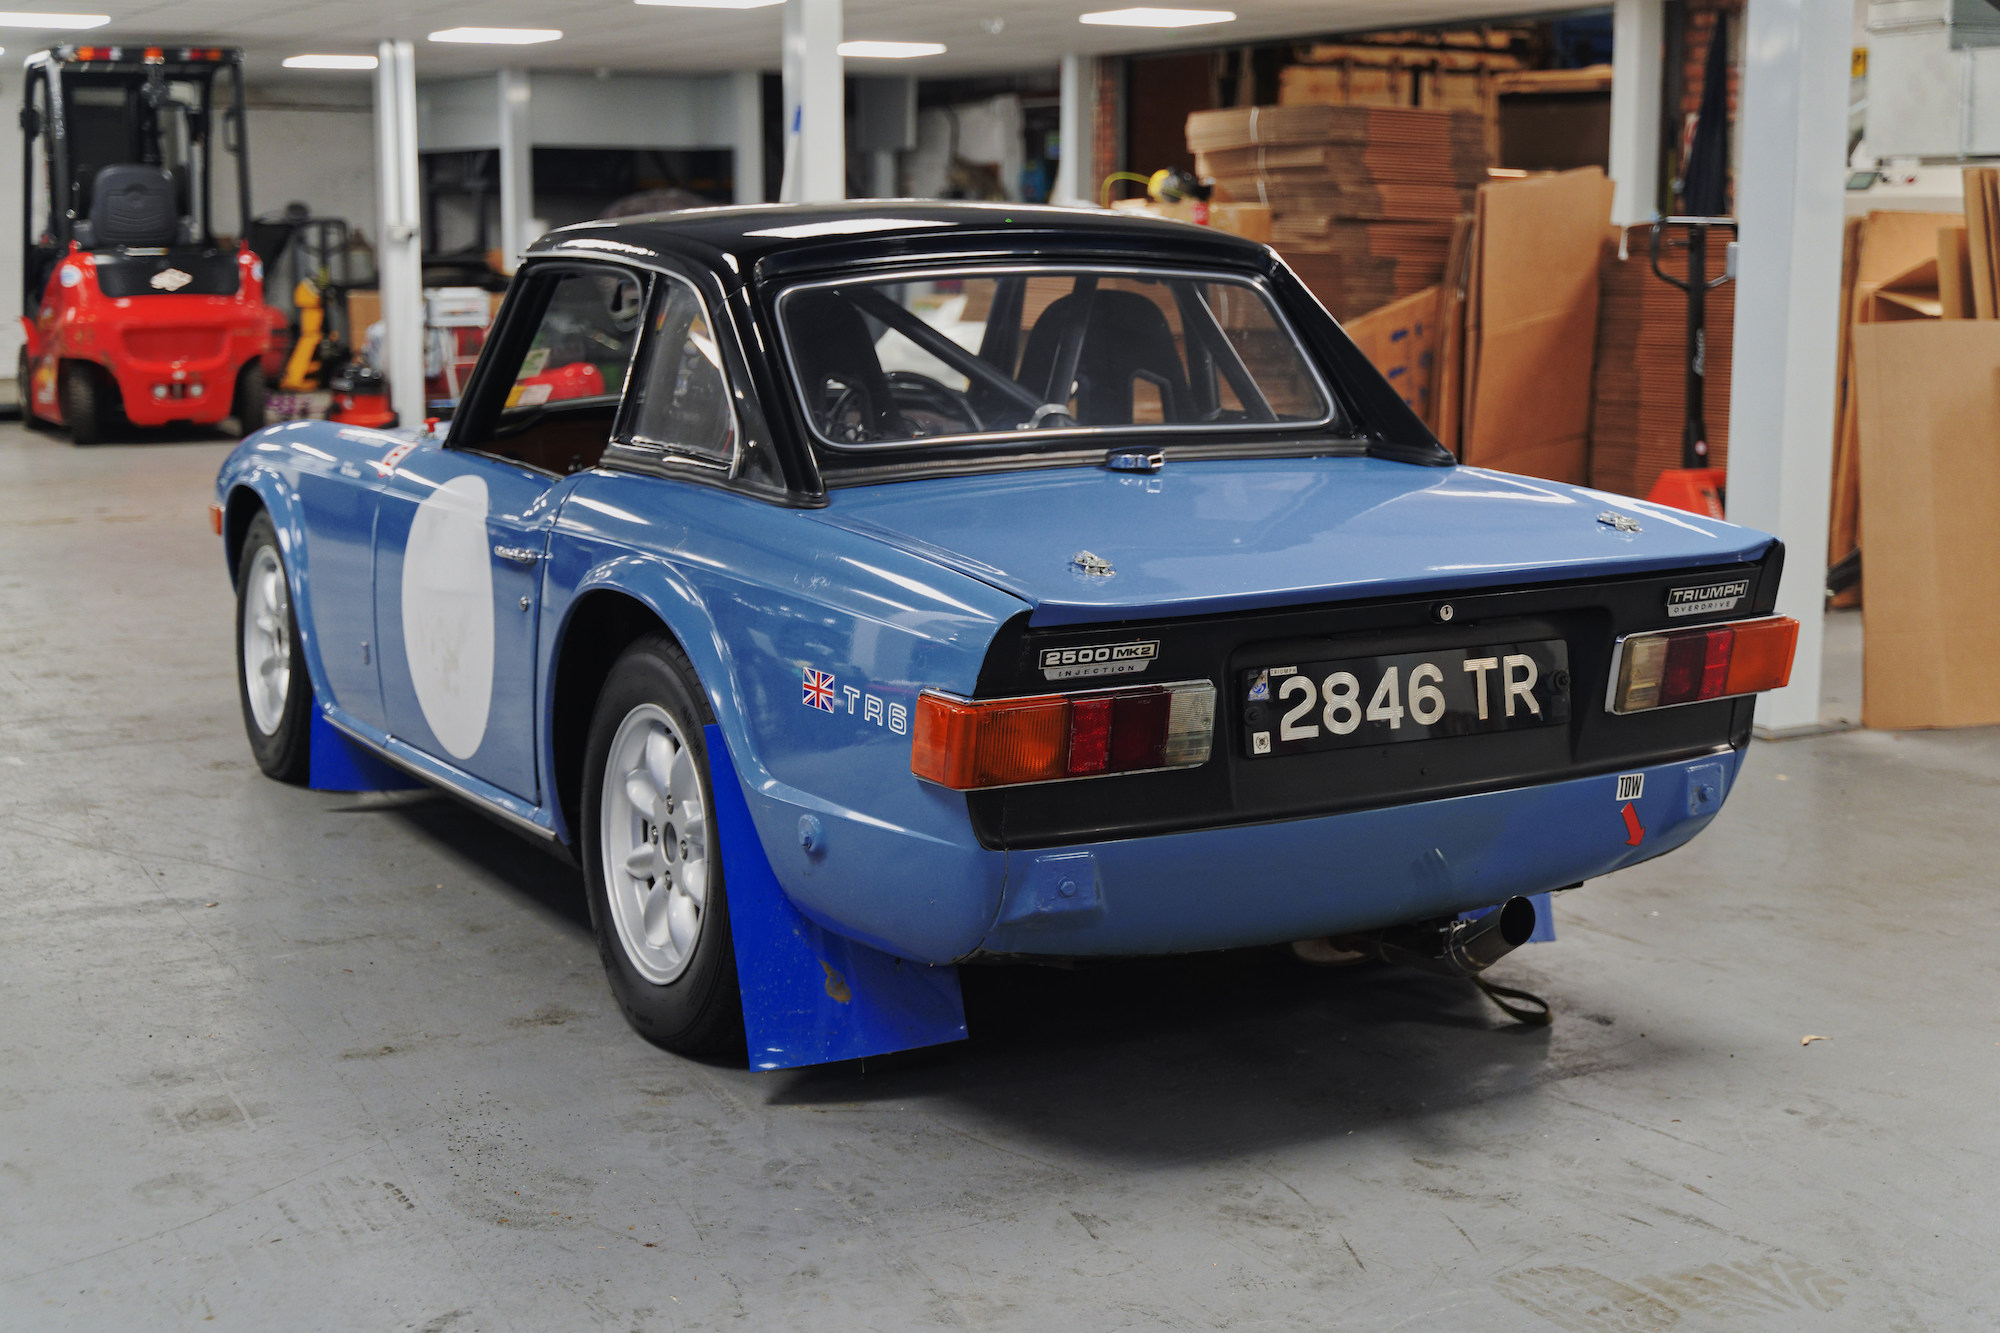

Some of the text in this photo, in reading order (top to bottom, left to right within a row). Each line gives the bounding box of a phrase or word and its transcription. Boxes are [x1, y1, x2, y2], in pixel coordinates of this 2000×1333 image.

[1673, 583, 1745, 602] TRIUMPH
[1673, 600, 1731, 613] OVERDRIVE
[1045, 647, 1110, 666] 2500
[1058, 665, 1135, 677] INJECTION
[1278, 653, 1540, 742] 2846 TR
[843, 684, 907, 735] TR6
[1619, 775, 1643, 798] TOW
